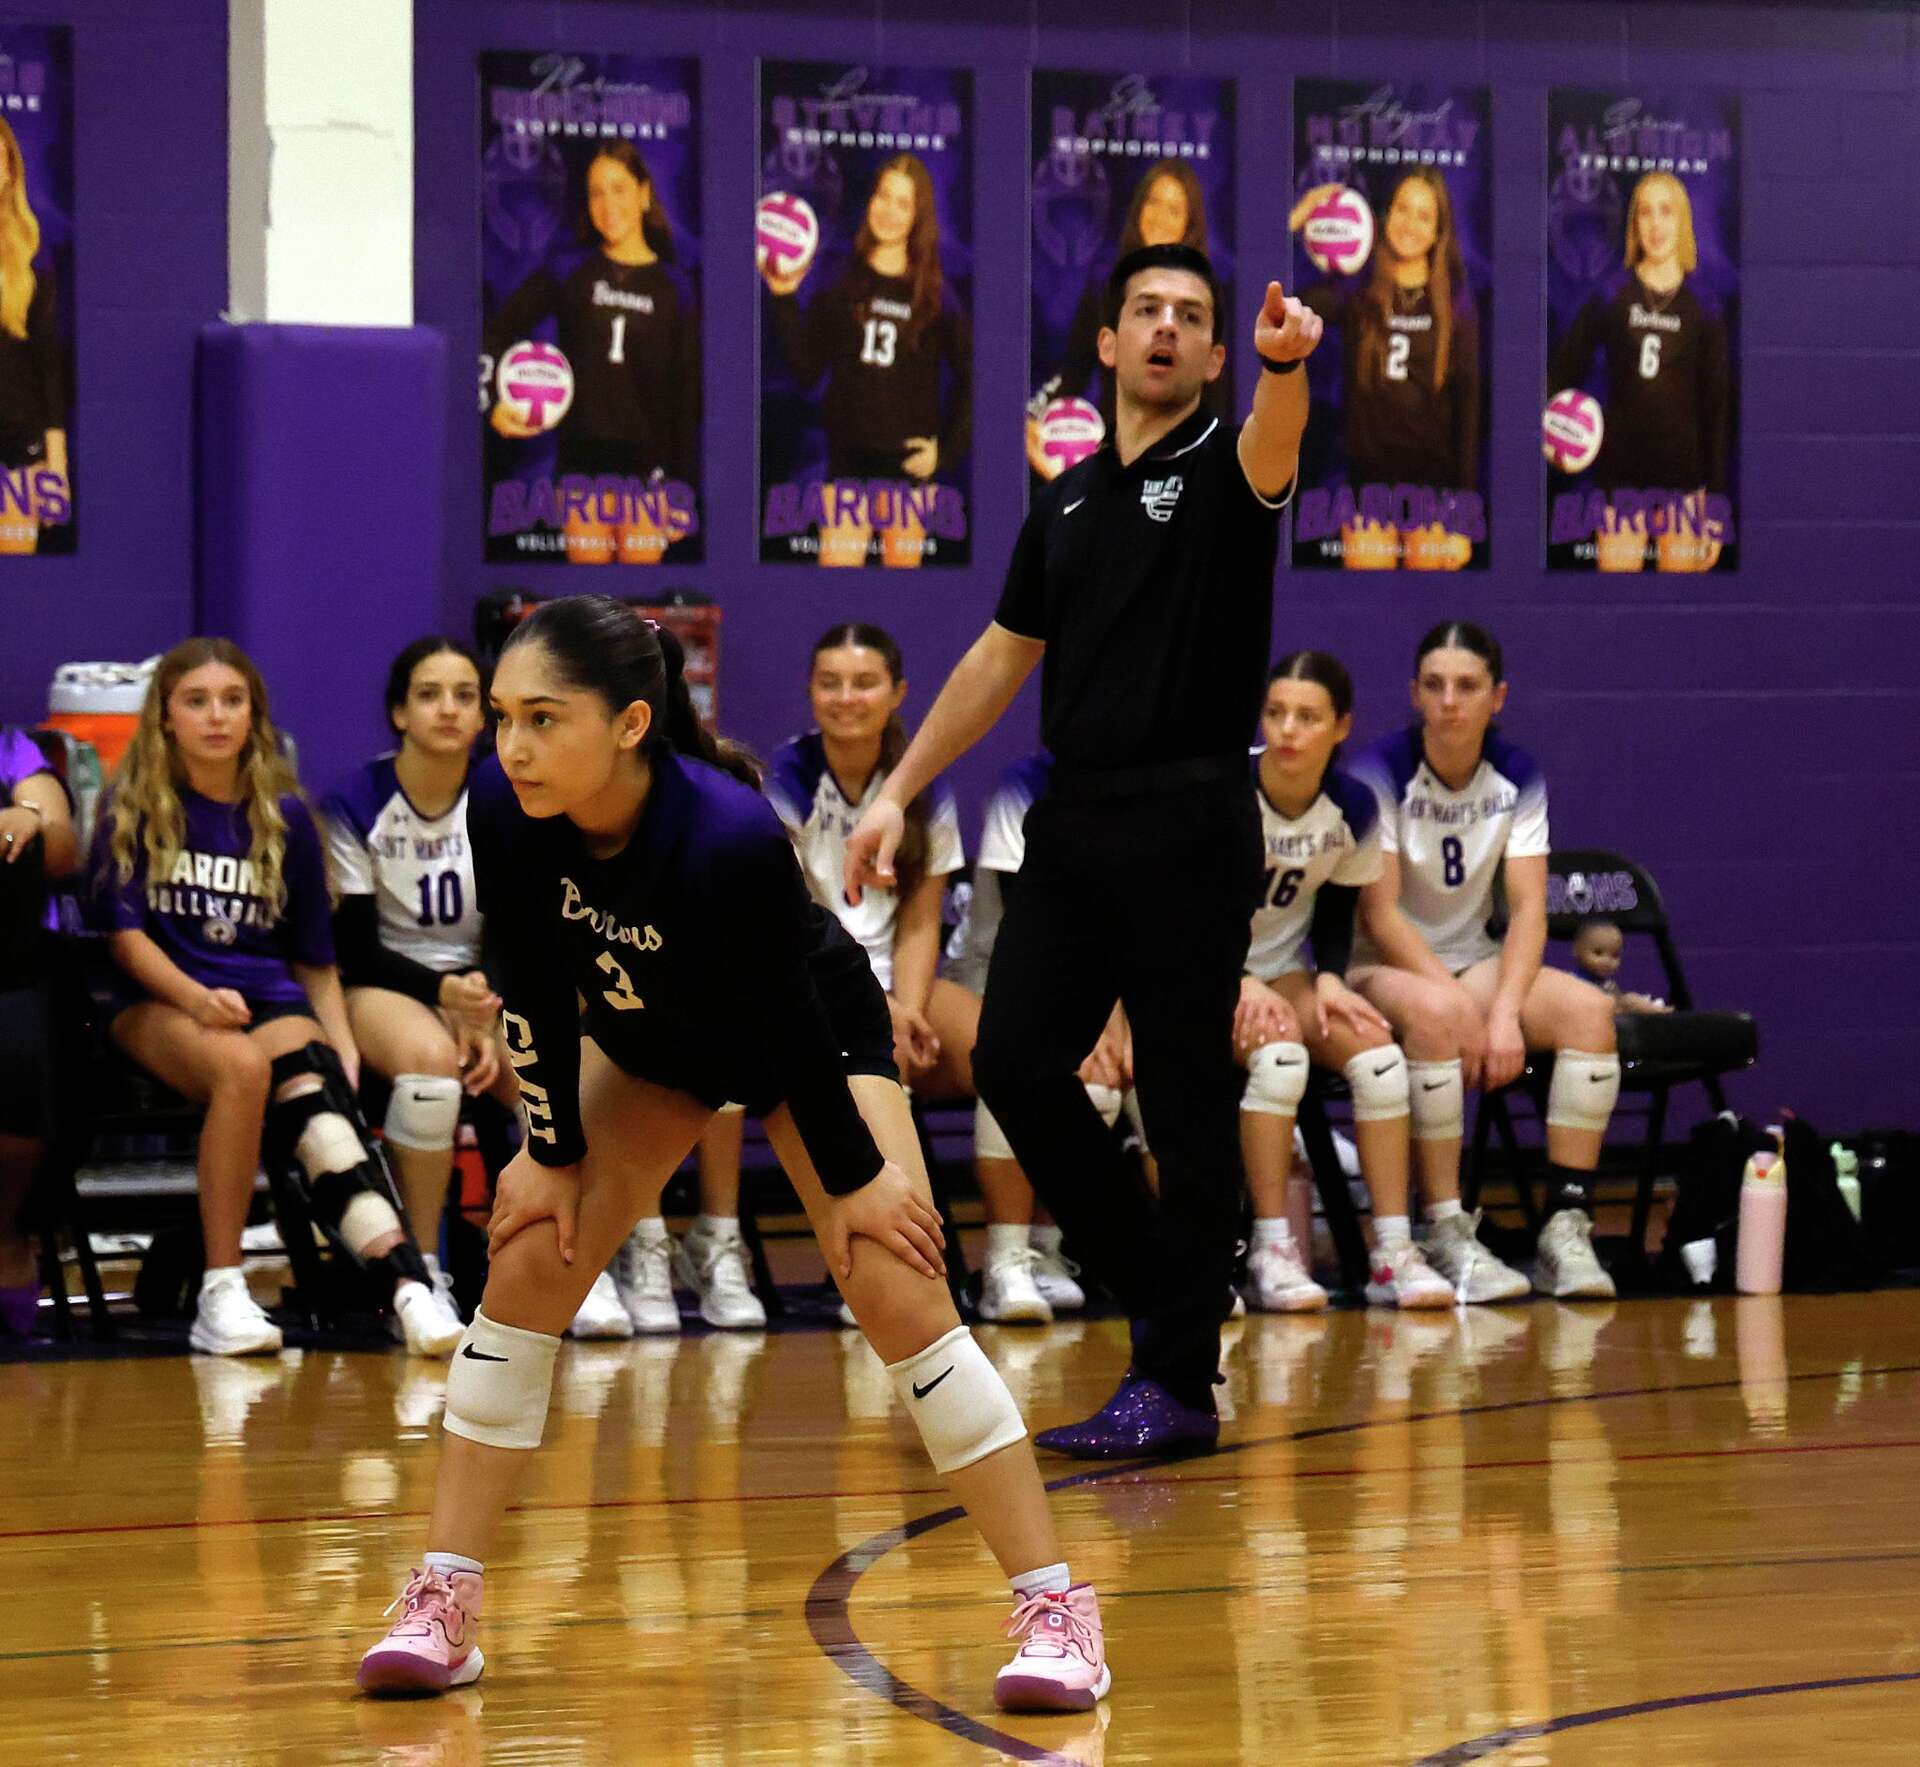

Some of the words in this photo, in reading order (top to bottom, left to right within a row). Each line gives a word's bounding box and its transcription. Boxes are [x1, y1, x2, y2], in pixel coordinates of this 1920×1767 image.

[515, 118, 666, 139] SOPHOMORE
[786, 127, 946, 151] SOPHOMORE
[1055, 137, 1210, 160] SOPHOMORE
[1317, 145, 1466, 168] SOPHOMORE
[1579, 153, 1708, 174] FRESHMAN
[607, 315, 627, 364] 1
[859, 318, 898, 367] 13
[1386, 333, 1411, 382] 2
[1639, 333, 1662, 379] 6
[490, 474, 699, 537] BARONS
[765, 477, 967, 542] BARONS
[1297, 482, 1487, 543] BARONS
[1550, 486, 1736, 545] BARONS
[171, 849, 258, 895] ARON
[1442, 835, 1465, 887] 8
[417, 870, 463, 926] 10
[595, 950, 645, 1010] 3
